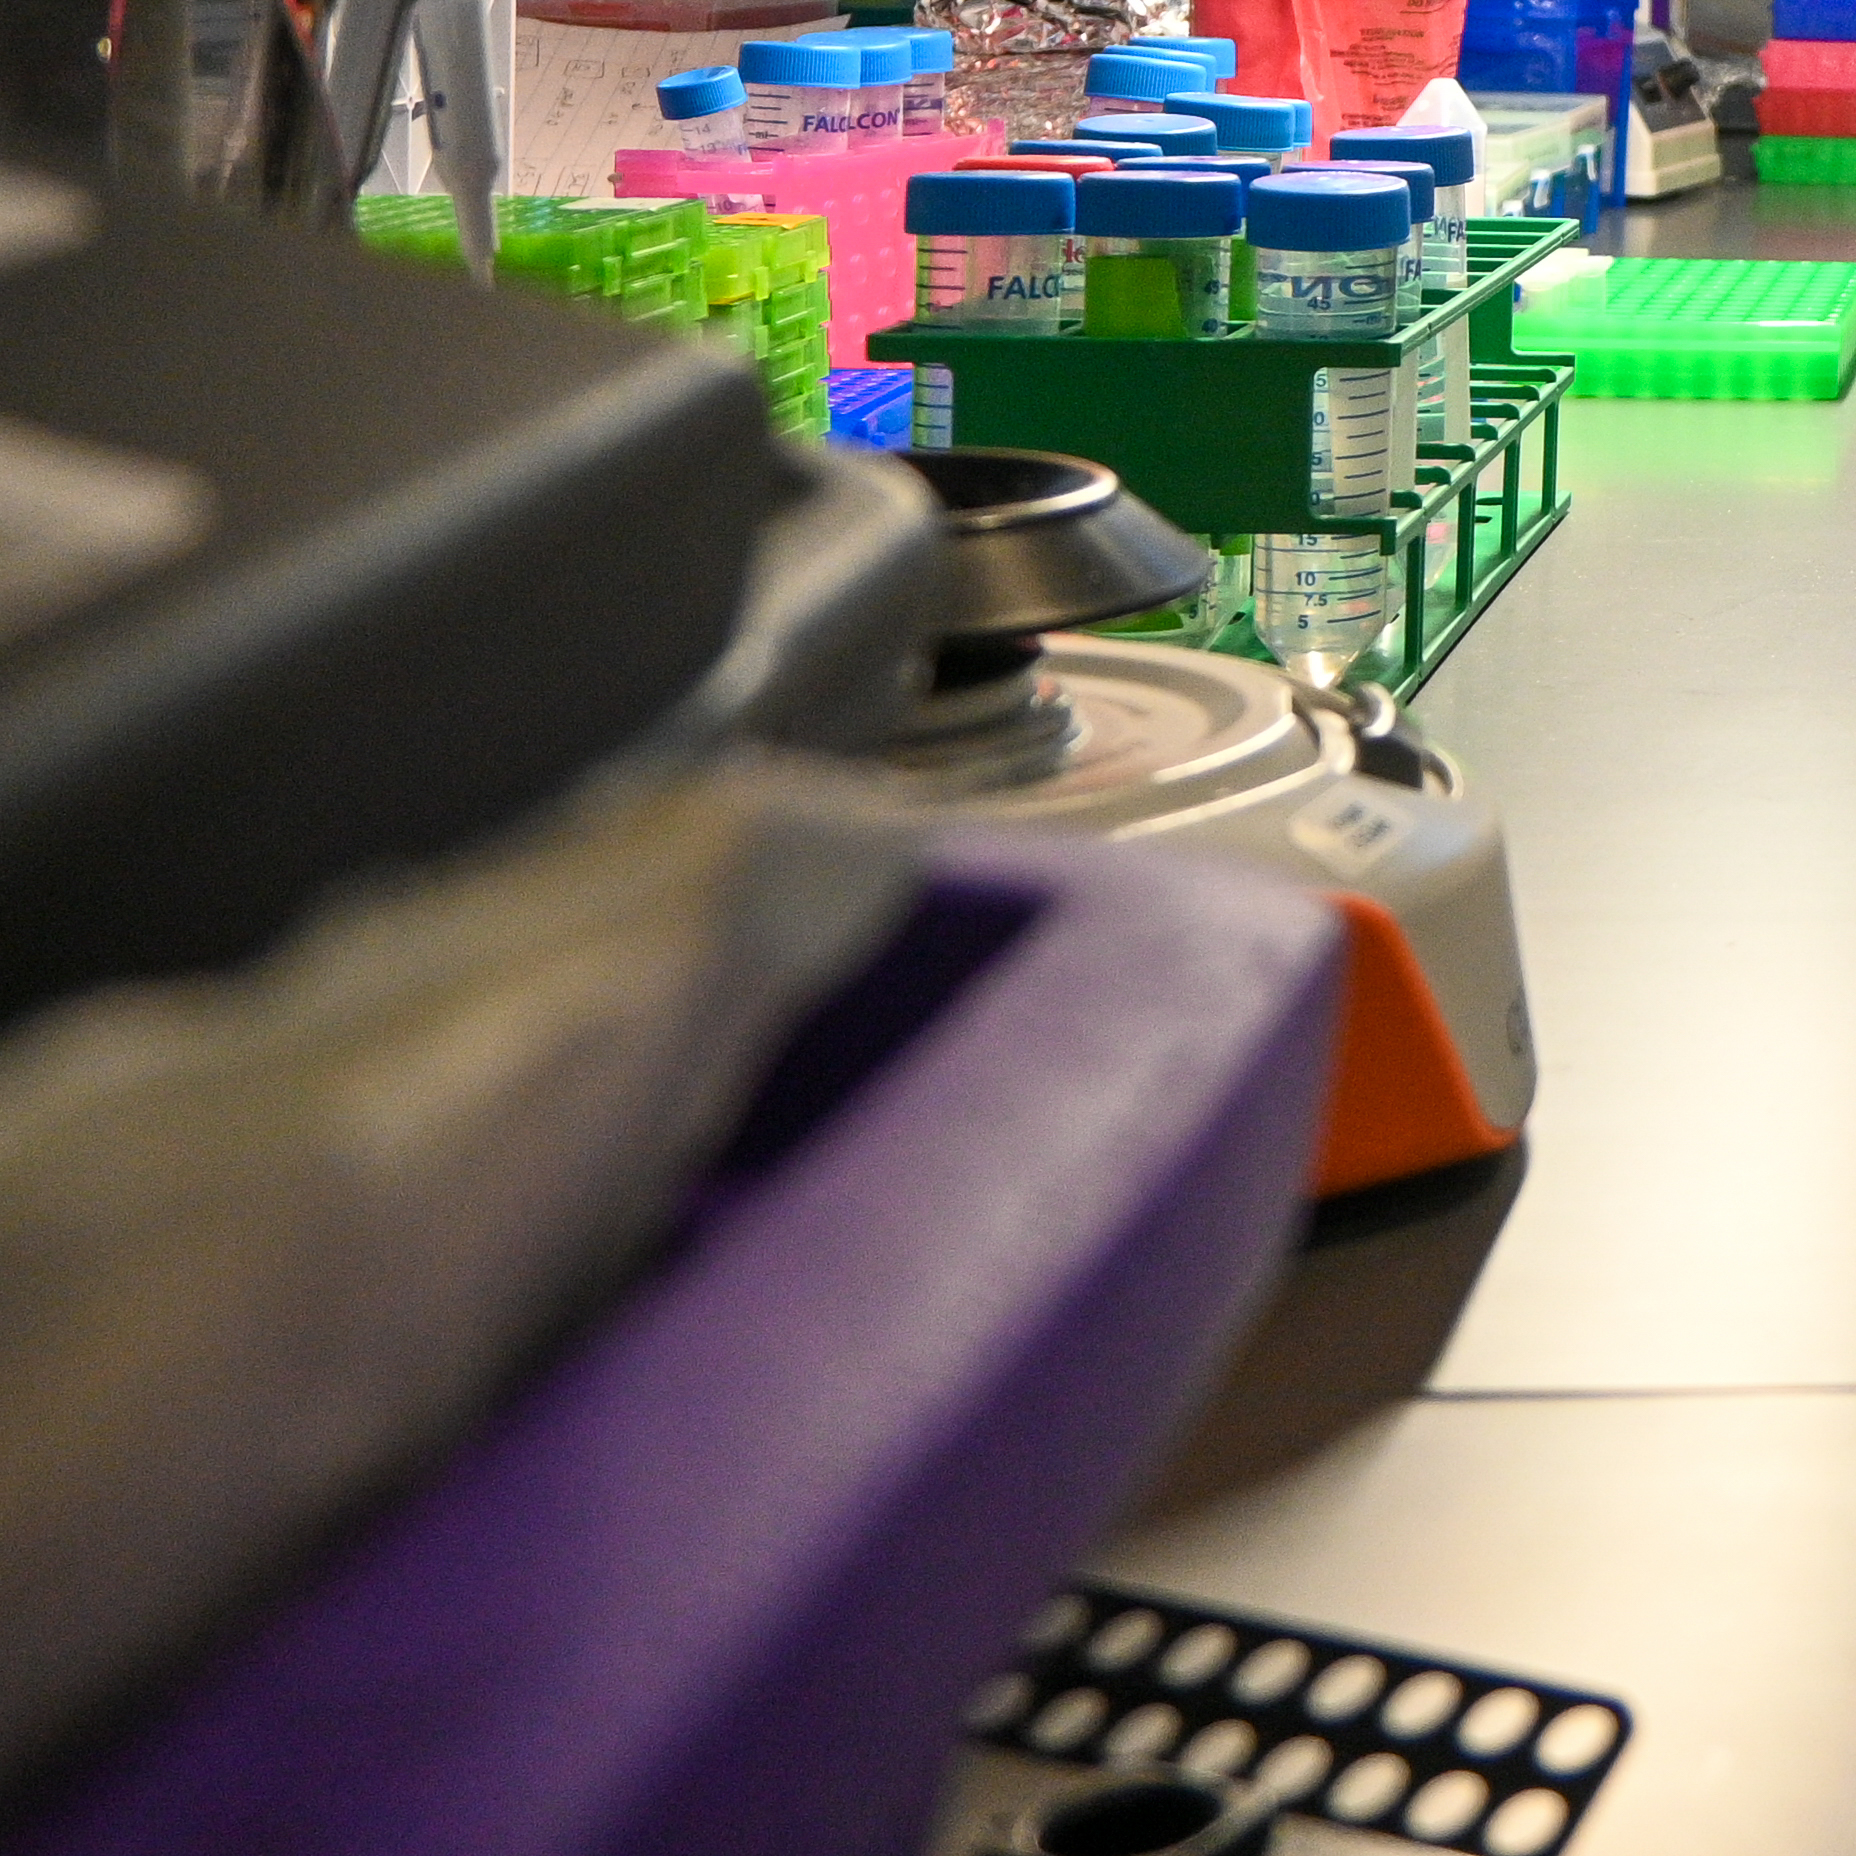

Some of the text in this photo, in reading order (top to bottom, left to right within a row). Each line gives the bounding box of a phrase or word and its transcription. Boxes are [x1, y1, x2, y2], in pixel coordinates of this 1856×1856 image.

[1307, 297, 1331, 311] 45
[1295, 572, 1316, 586] 10
[1304, 592, 1328, 606] 7.5
[1298, 615, 1309, 630] 5
